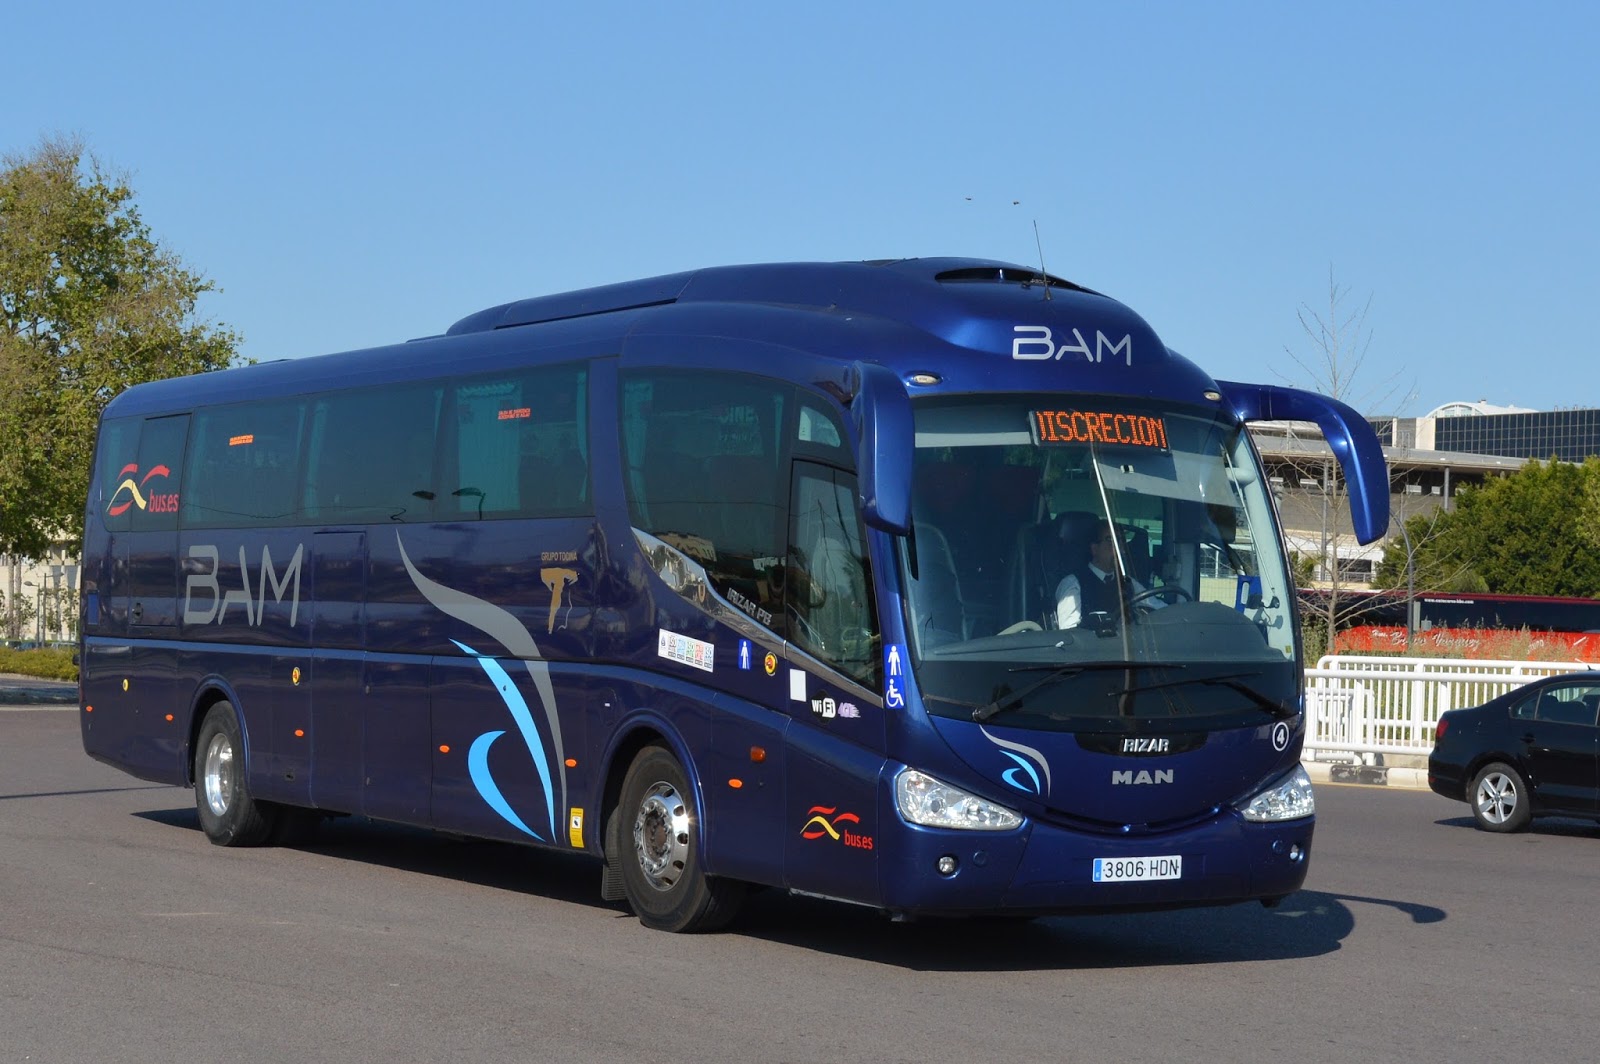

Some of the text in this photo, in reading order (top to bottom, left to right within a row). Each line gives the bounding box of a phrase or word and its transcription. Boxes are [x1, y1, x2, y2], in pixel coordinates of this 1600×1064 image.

[1012, 325, 1132, 366] BAM
[541, 551, 559, 561] GRUPO
[183, 543, 304, 628] BAM
[727, 587, 773, 626] IRIZAR PB
[1112, 769, 1174, 785] MAN
[844, 829, 873, 850] bus.es
[1105, 861, 1144, 878] 3806
[1149, 859, 1178, 876] HDN
